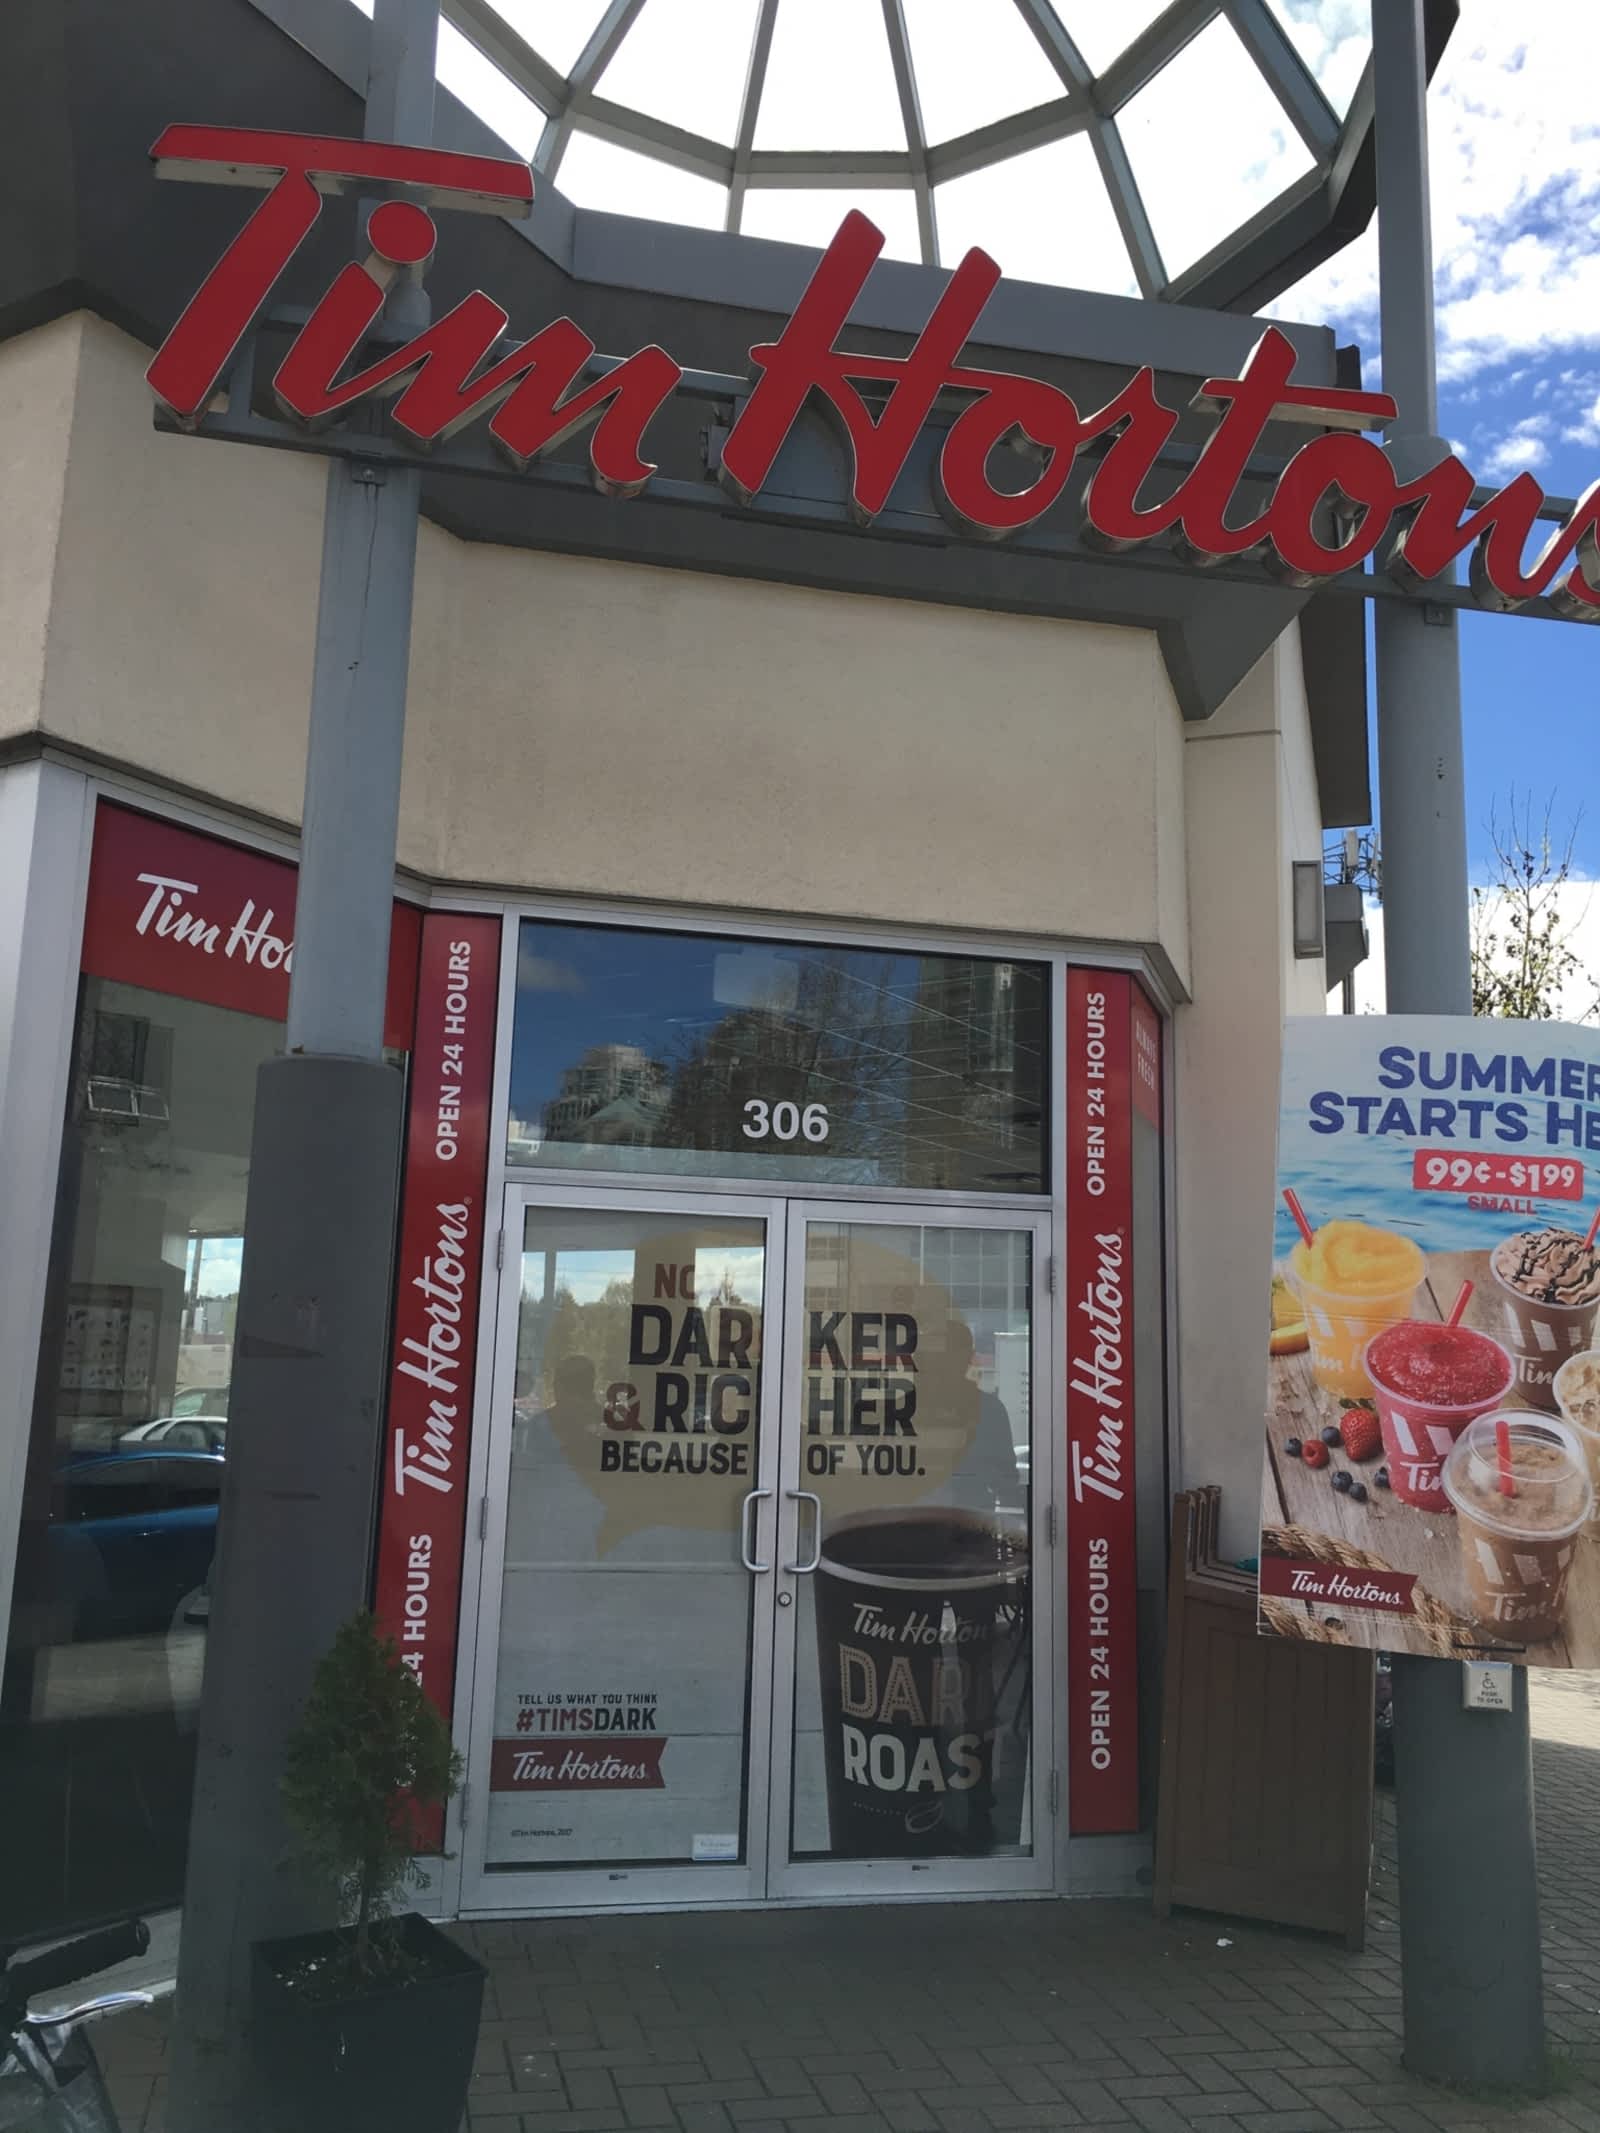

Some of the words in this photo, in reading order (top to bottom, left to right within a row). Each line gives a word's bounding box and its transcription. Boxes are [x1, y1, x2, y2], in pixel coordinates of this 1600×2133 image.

[145, 122, 682, 483] Tim
[135, 873, 220, 953] Tim
[444, 941, 471, 1034] HOURS
[441, 1043, 464, 1075] 24
[1087, 991, 1106, 1079] HOURS
[435, 1085, 461, 1160] OPEN
[742, 1099, 829, 1142] 306
[1088, 1087, 1106, 1117] 24
[1308, 1091, 1529, 1142] STARTS
[1087, 1124, 1106, 1196] OPEN
[1467, 1194, 1538, 1215] SMALL
[397, 1201, 470, 1393] Hortons
[1069, 1232, 1125, 1409] Hortons
[395, 1401, 459, 1496] Tim
[600, 1440, 748, 1475] BECAUSE
[807, 1444, 844, 1475] OF
[855, 1444, 926, 1476] YOU.
[1071, 1415, 1125, 1503] Tim
[403, 1534, 432, 1641] HOURS
[853, 1602, 897, 1641] Tim
[1089, 1537, 1109, 1636] HOURS
[1291, 1570, 1325, 1594] Tim
[1327, 1573, 1400, 1605] Hortons
[1091, 1646, 1109, 1679] 24
[516, 1707, 657, 1732] #TIMSDARK
[518, 1694, 542, 1705] TELL
[547, 1694, 562, 1705] US
[566, 1694, 598, 1705] WHAT
[602, 1694, 623, 1704] YOU
[626, 1693, 657, 1704] THINK
[1091, 1690, 1111, 1770] OPEN
[513, 1751, 554, 1781] Tim
[557, 1749, 646, 1781] Hortons
